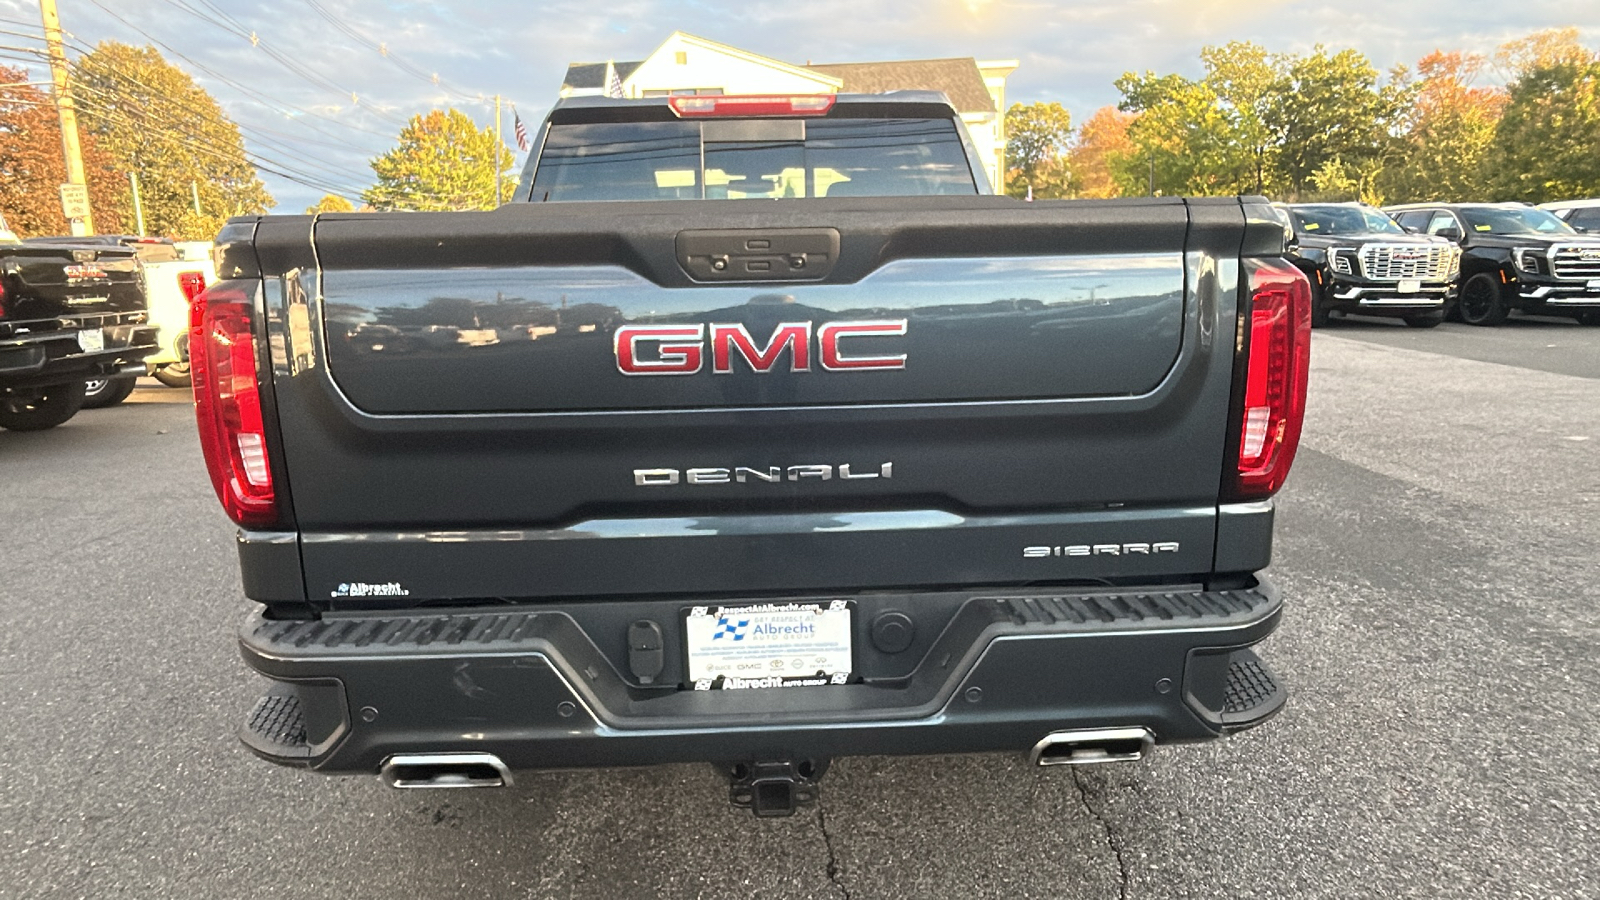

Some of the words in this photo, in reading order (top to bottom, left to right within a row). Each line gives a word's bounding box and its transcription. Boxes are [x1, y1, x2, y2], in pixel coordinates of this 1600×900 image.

[614, 319, 908, 376] GMC
[633, 462, 893, 486] DENALI
[1023, 542, 1180, 558] SIERRA
[350, 582, 401, 594] Albrecht
[753, 622, 815, 635] Albrecht
[722, 675, 783, 690] Albrecht
